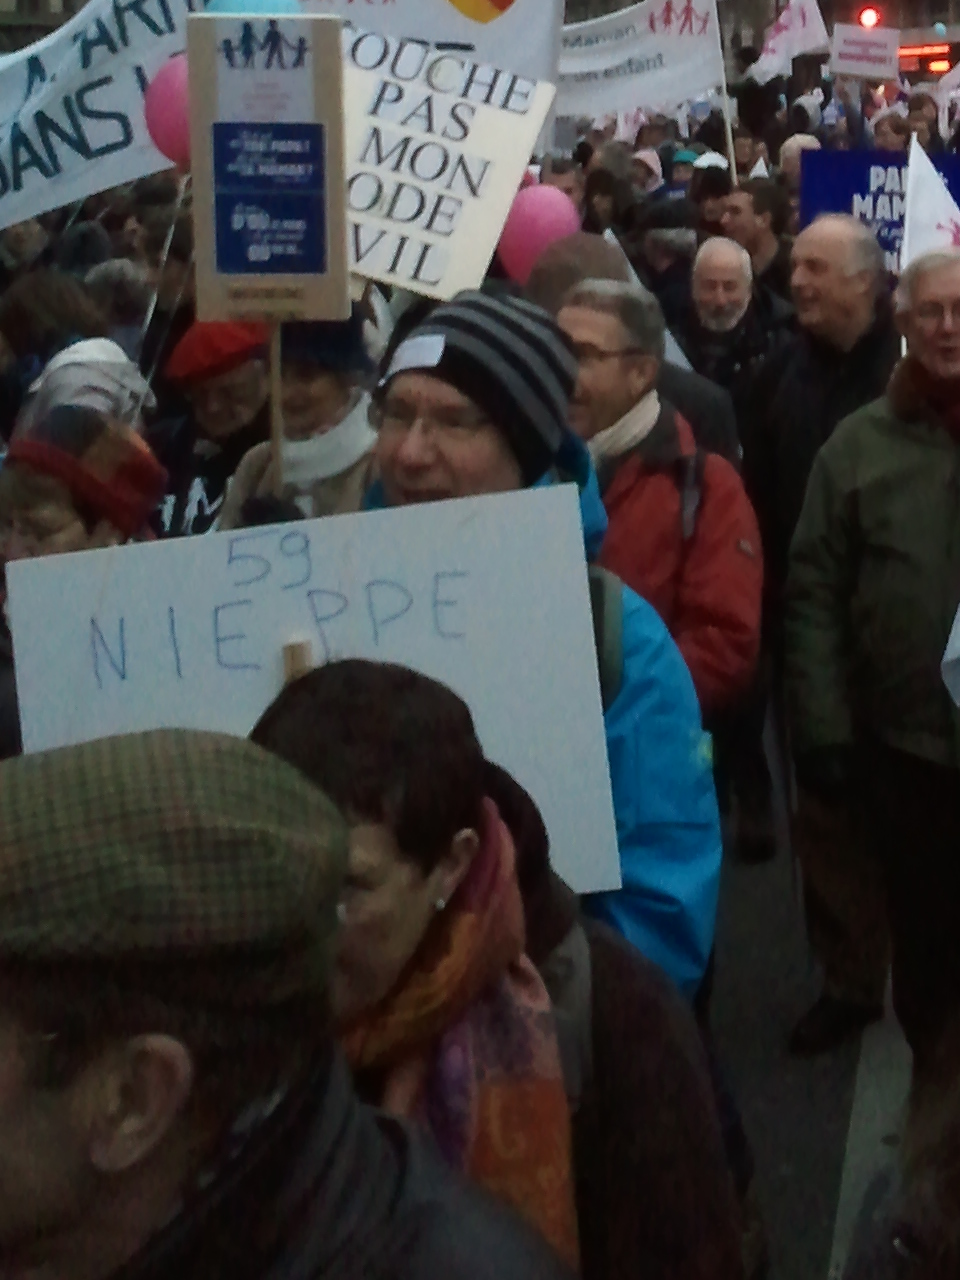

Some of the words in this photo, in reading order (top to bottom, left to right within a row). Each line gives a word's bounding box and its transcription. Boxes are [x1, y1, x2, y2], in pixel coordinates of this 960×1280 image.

[351, 31, 537, 116] OUCHE
[368, 80, 476, 143] PAS
[358, 126, 492, 198] MON
[347, 172, 463, 237] ODE
[852, 192, 907, 221] MAM
[350, 222, 441, 287] VIL
[227, 531, 312, 590] 59
[90, 570, 469, 690] NIEPPE
